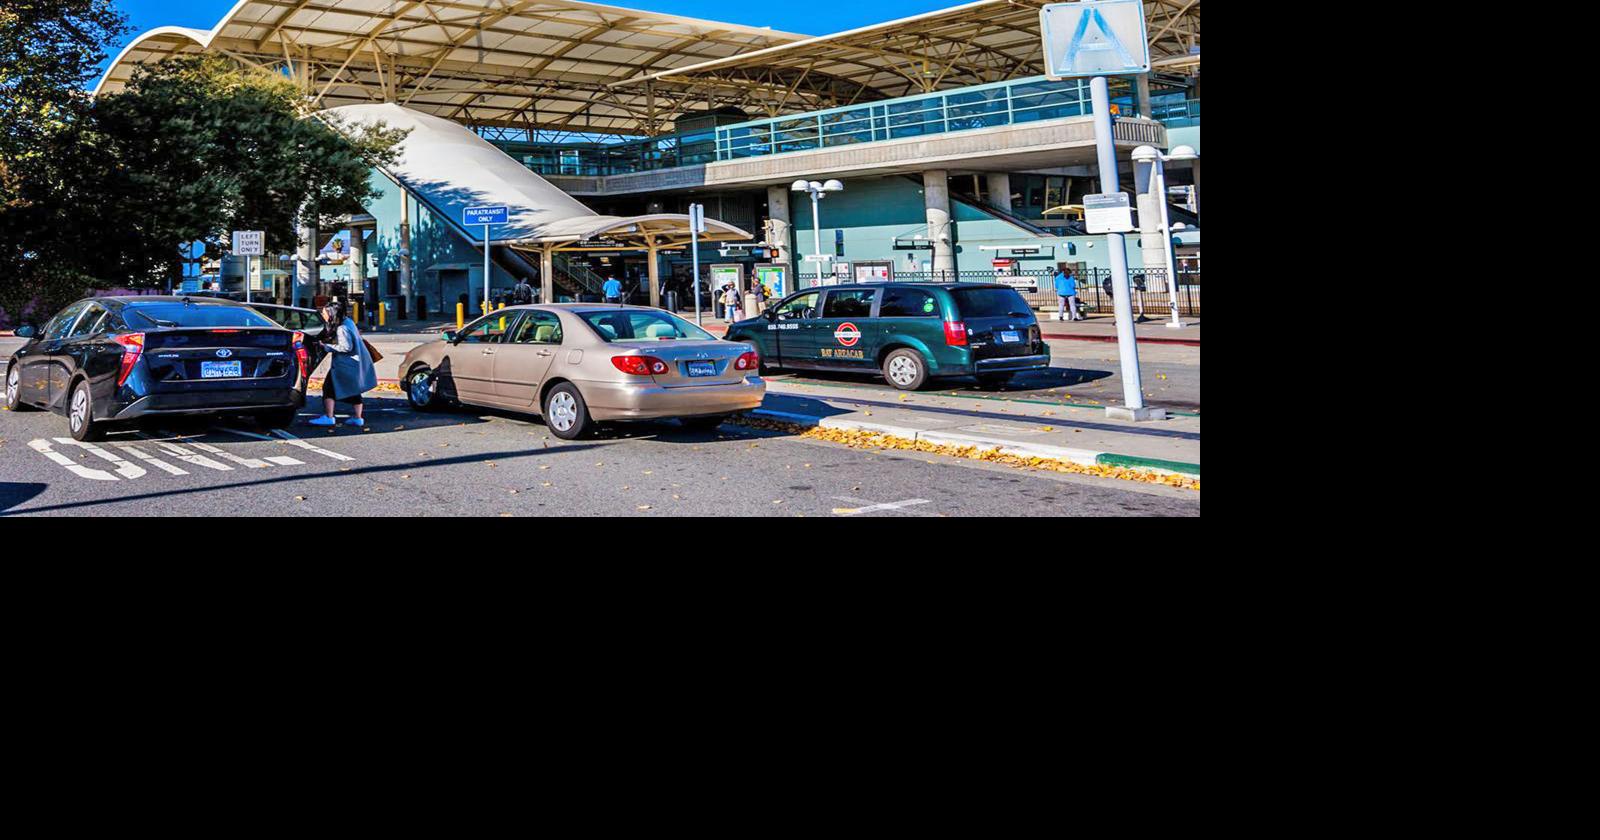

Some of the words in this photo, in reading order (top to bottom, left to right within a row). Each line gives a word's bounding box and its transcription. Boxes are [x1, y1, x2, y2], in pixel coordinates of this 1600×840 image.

[1058, 8, 1138, 72] A
[467, 208, 504, 216] PARATRANSIT
[820, 348, 832, 357] BAY
